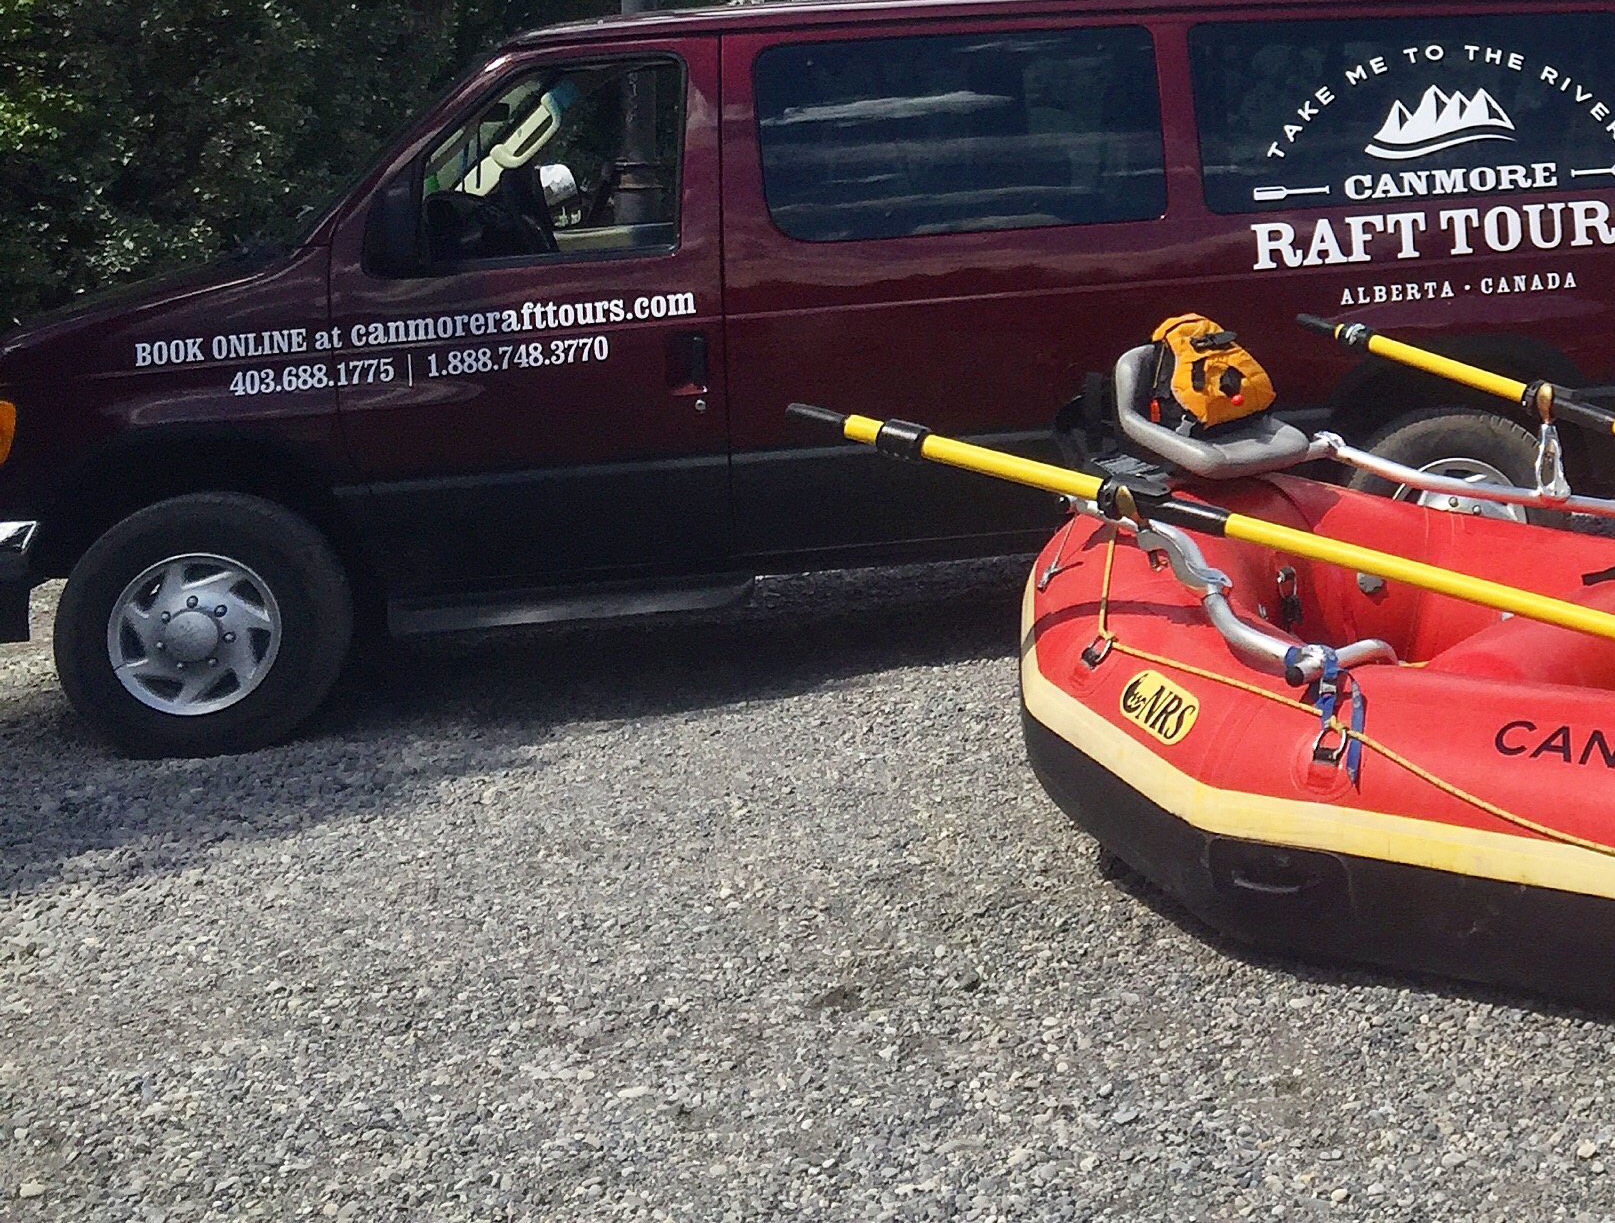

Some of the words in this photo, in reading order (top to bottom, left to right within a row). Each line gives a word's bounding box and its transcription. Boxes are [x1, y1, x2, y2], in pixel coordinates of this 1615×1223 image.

[1267, 86, 1336, 158] TAKE
[1345, 56, 1388, 85] ME
[1403, 44, 1444, 63] TO
[1464, 45, 1525, 70] THE
[1343, 162, 1558, 201] CANMORE
[1251, 211, 1427, 271] RAFT
[1340, 280, 1455, 306] ALBERTA
[1480, 272, 1578, 295] CANADA
[135, 338, 205, 367] BOOK
[212, 328, 307, 360] ONLINE
[314, 326, 343, 349] at
[350, 291, 697, 347] canmorerafttours.com
[229, 357, 395, 397] 403.688.1775
[427, 335, 609, 377] 1.888.748.3770
[1135, 685, 1197, 739] NRS
